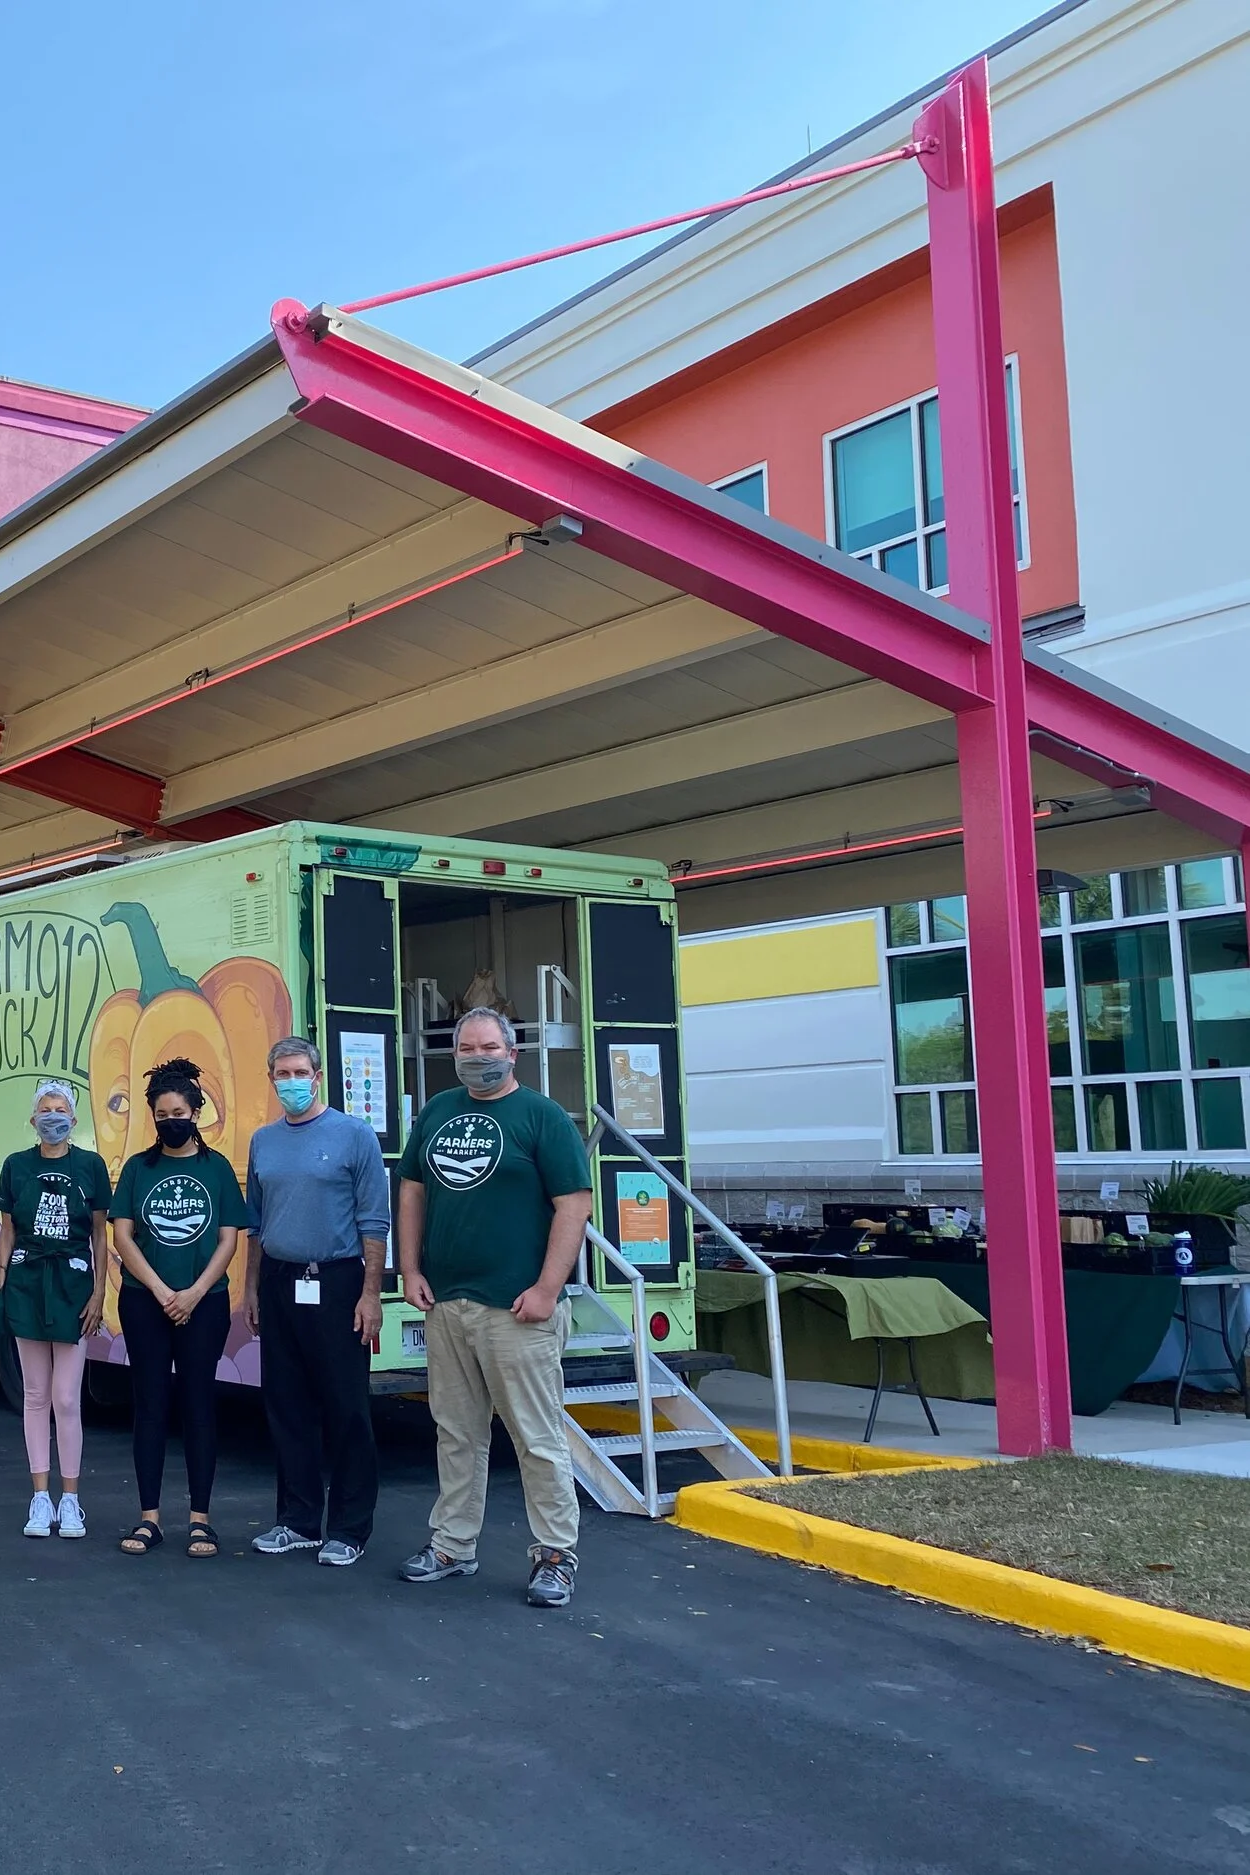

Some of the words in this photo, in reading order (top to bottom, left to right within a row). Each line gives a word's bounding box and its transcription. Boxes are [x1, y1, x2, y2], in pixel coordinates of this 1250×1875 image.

[449, 1116, 494, 1131] FORSYTH
[446, 1148, 478, 1156] MARKET
[156, 1178, 201, 1193] FORSYTH
[162, 1208, 192, 1216] MARKET
